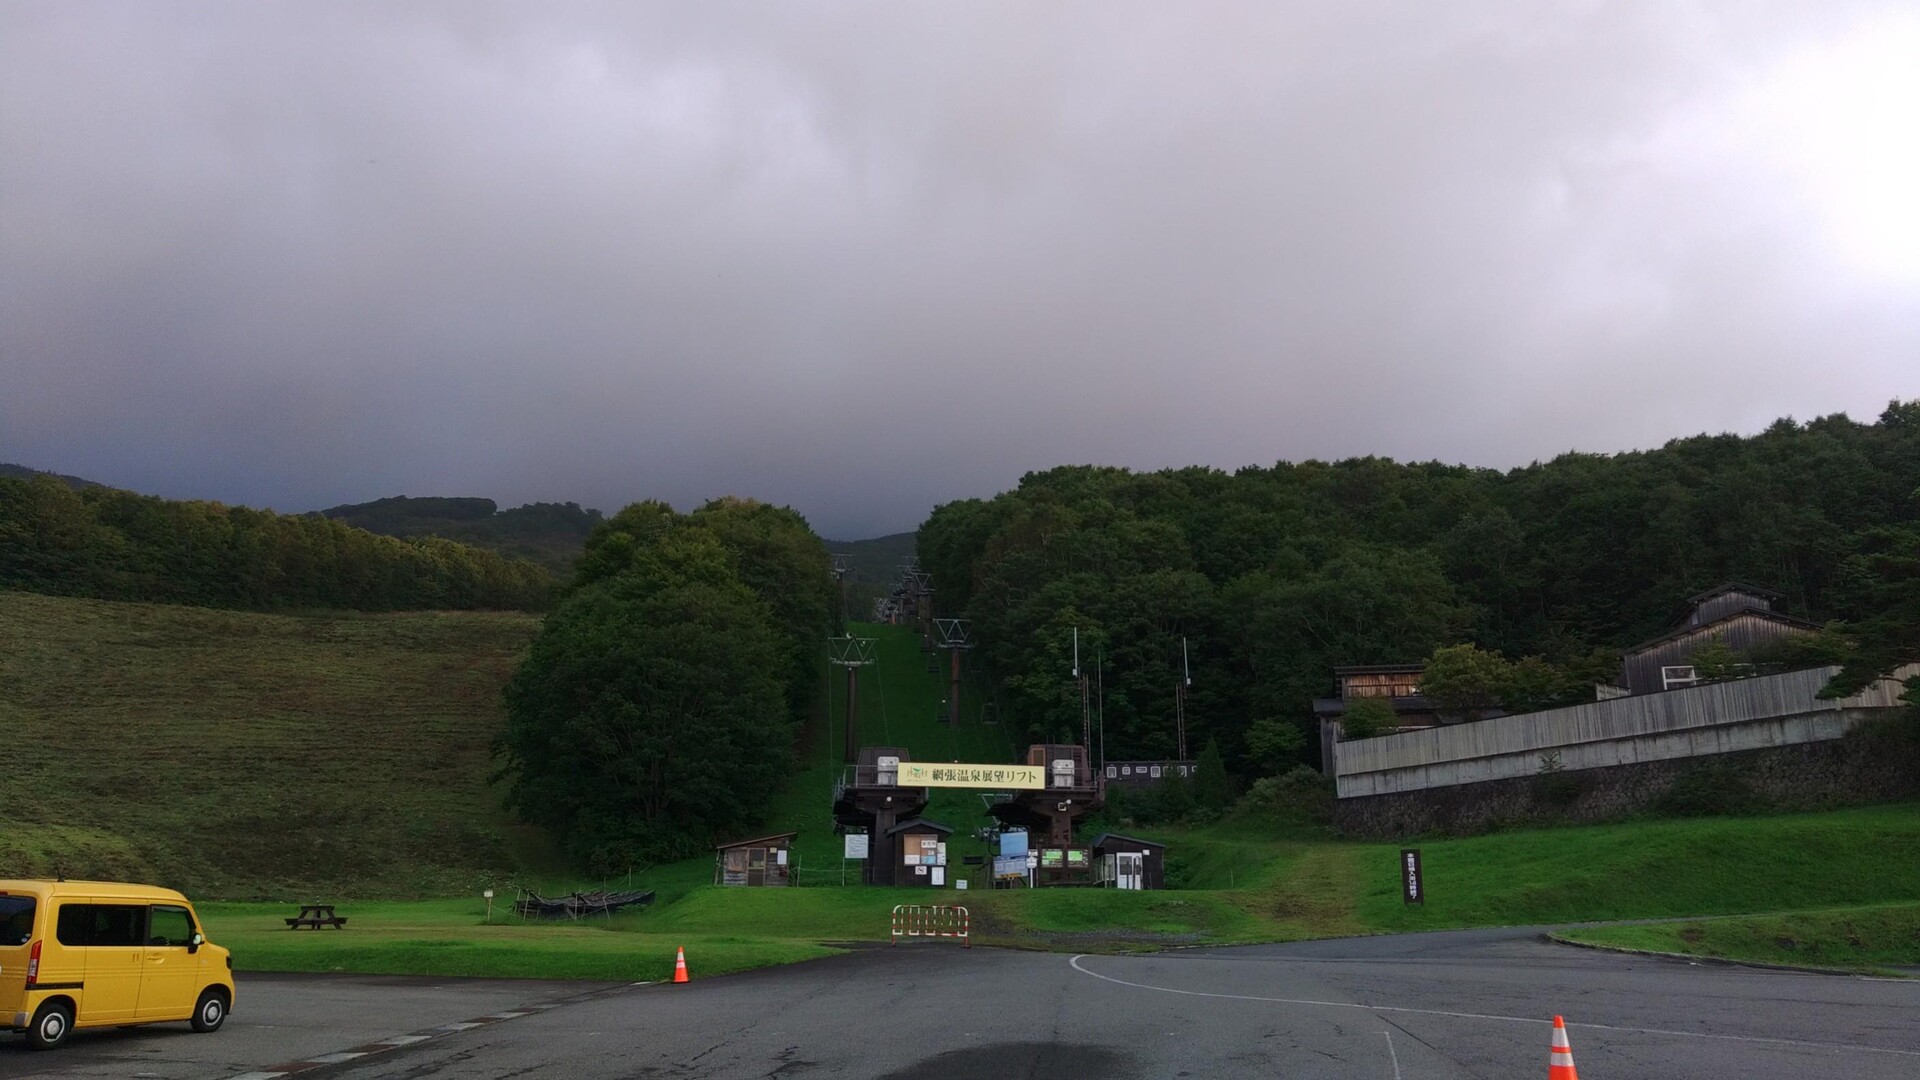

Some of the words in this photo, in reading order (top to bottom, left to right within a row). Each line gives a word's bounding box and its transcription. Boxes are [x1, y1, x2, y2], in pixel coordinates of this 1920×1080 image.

[932, 768, 1037, 784] 網張温泉展望リフト
